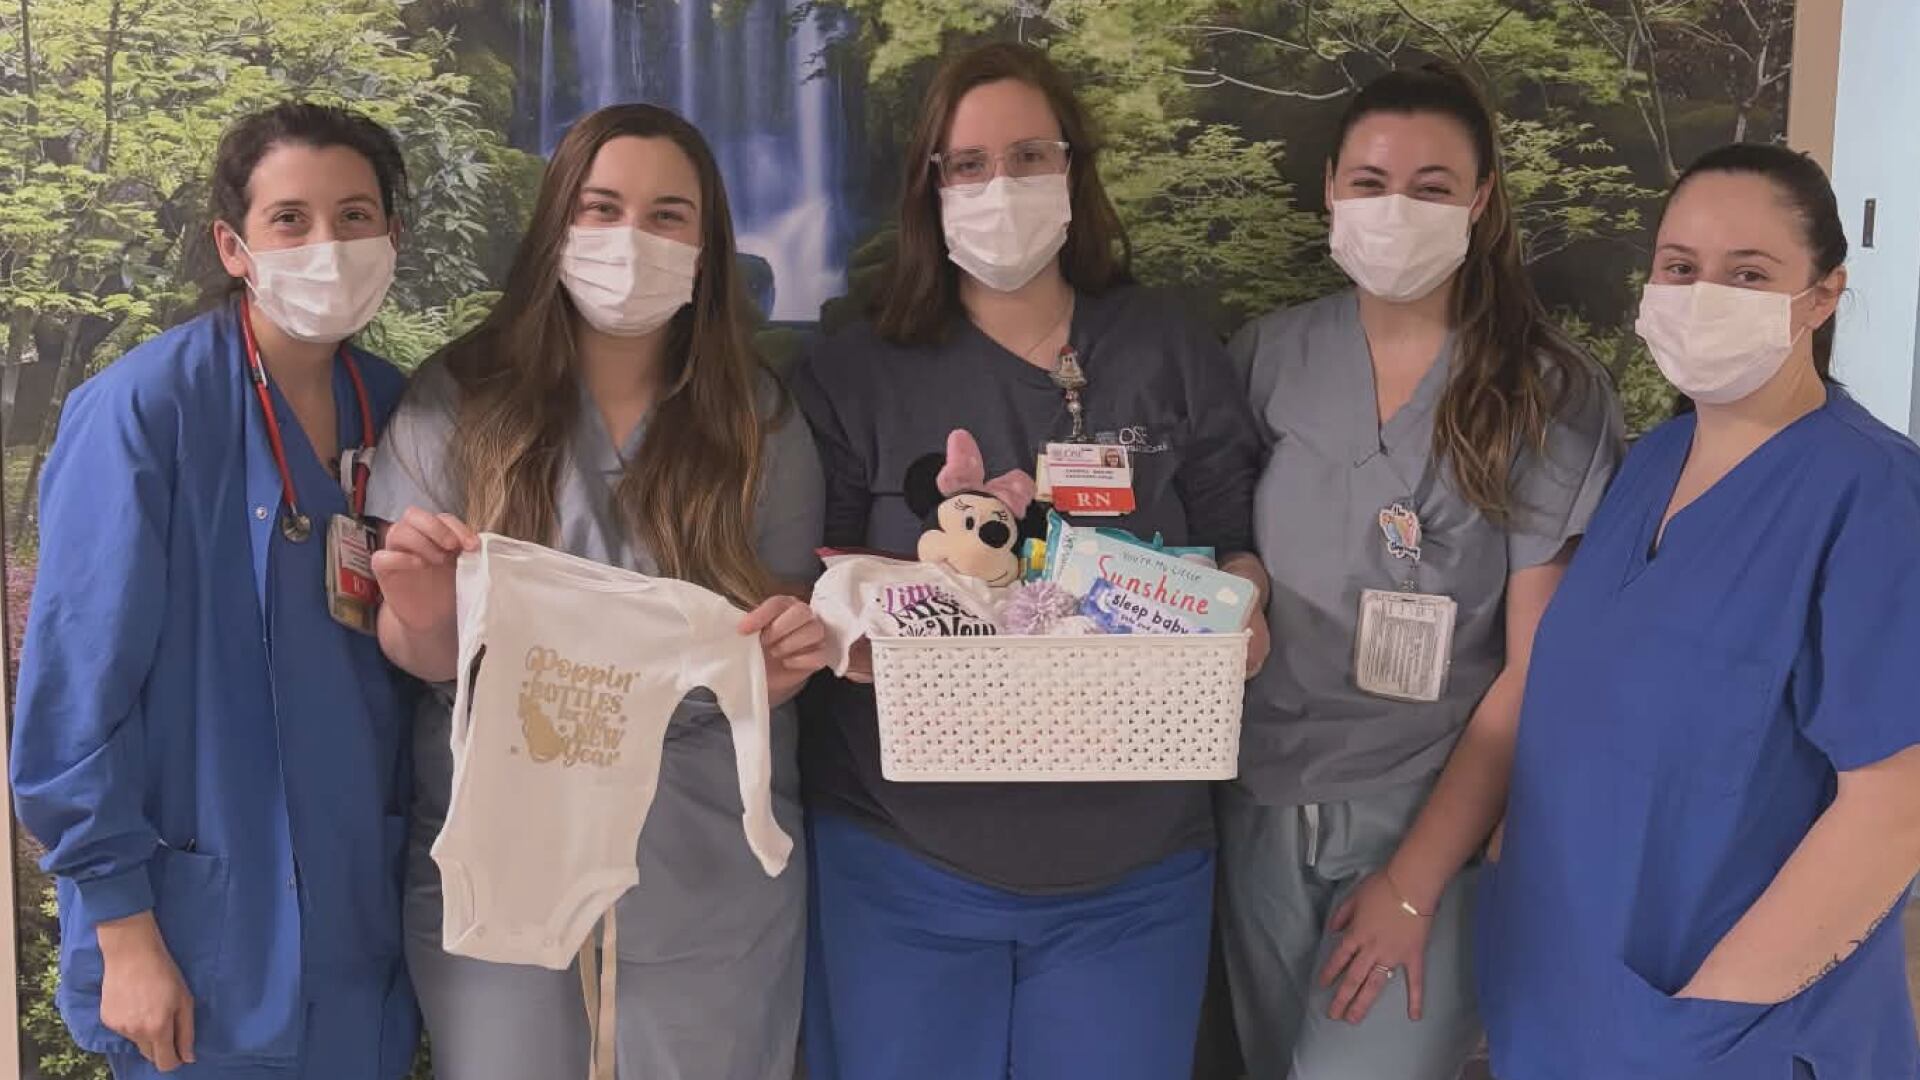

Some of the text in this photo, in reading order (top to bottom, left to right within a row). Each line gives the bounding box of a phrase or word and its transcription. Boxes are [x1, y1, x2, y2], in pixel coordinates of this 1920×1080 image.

[1076, 491, 1112, 507] RN
[1098, 554, 1209, 615] Sunshine
[1112, 593, 1149, 621] sleep
